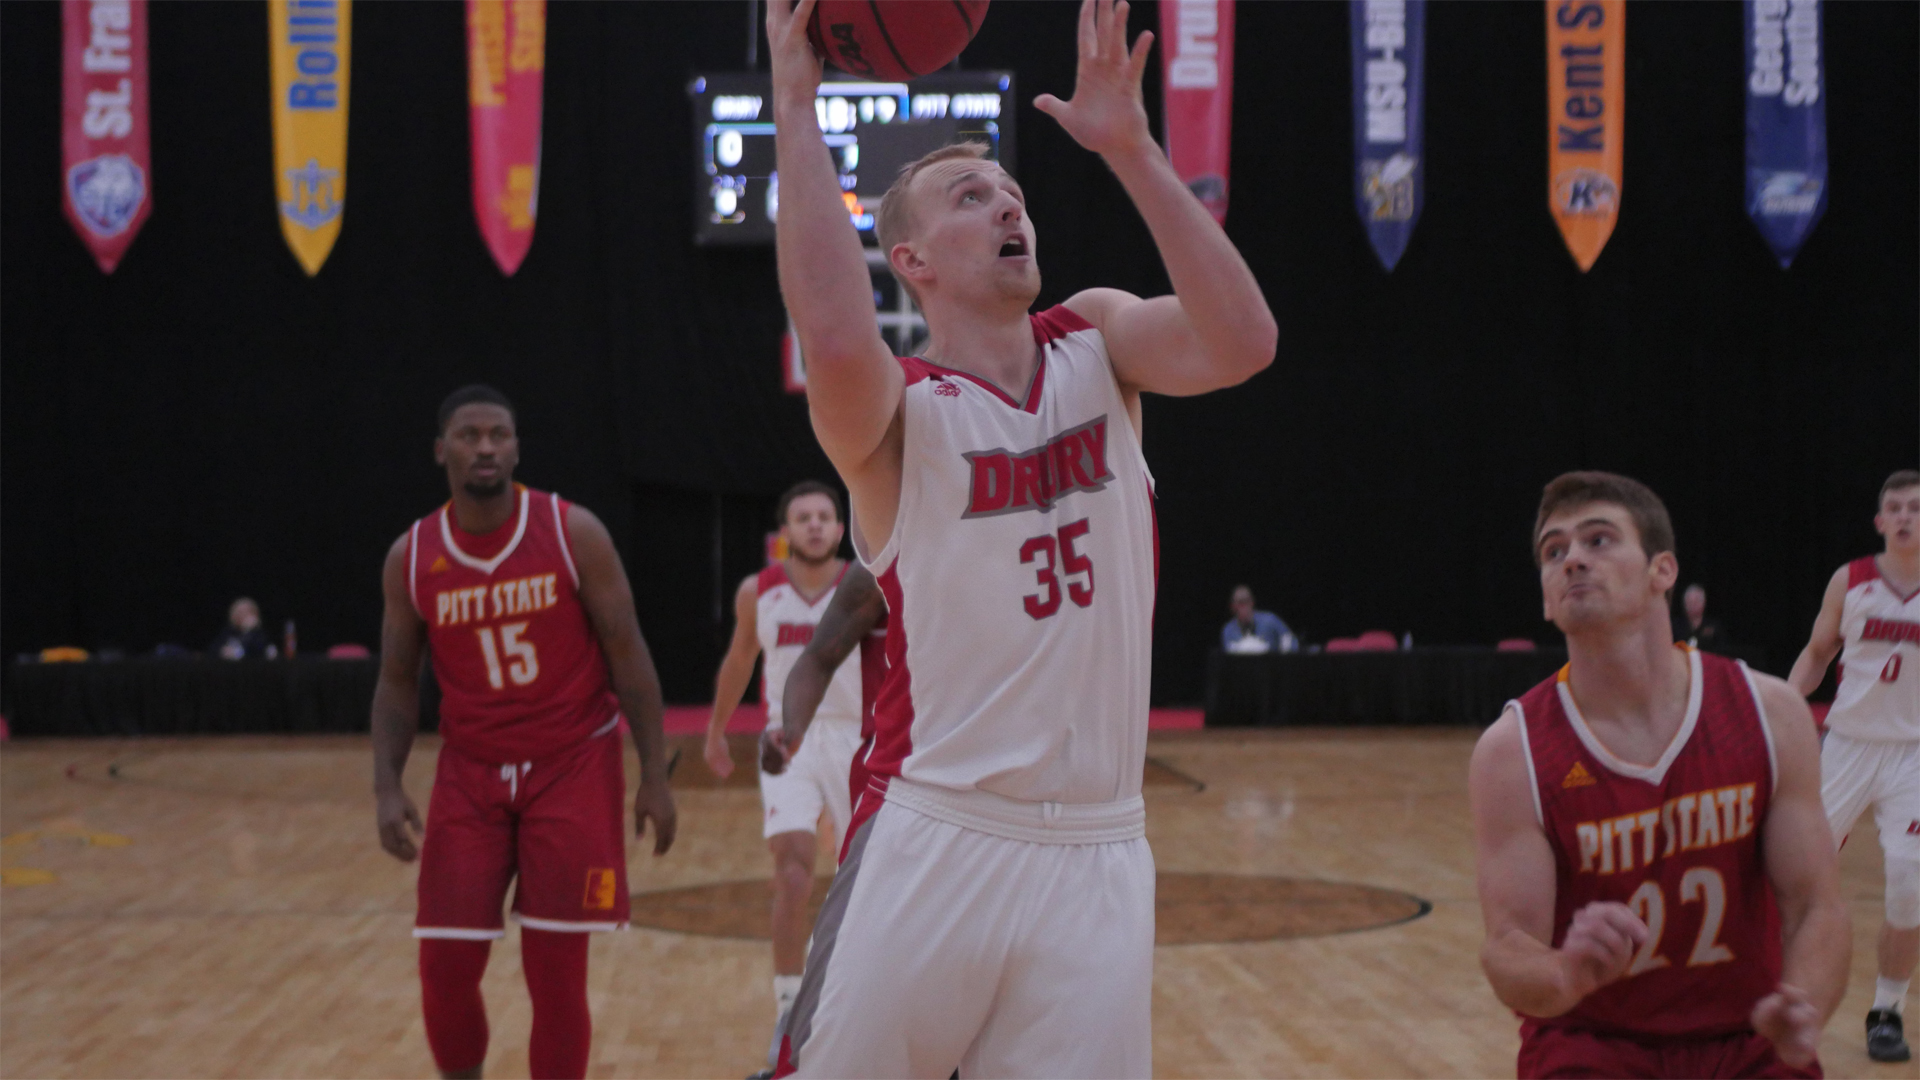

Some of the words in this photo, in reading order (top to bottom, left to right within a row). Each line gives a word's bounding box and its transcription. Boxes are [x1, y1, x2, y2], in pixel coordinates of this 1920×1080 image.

[829, 22, 884, 81] CAA
[1169, 0, 1219, 89] Dru
[1557, 44, 1605, 151] Kent
[960, 413, 1116, 520] DRURY
[435, 585, 488, 627] PITT
[491, 572, 558, 618] STATE
[1019, 516, 1095, 621] 35
[475, 621, 540, 690] 15
[1879, 653, 1903, 683] 0
[1575, 807, 1660, 875] PITT
[1662, 781, 1757, 859] STATE
[1625, 865, 1737, 978] 22
